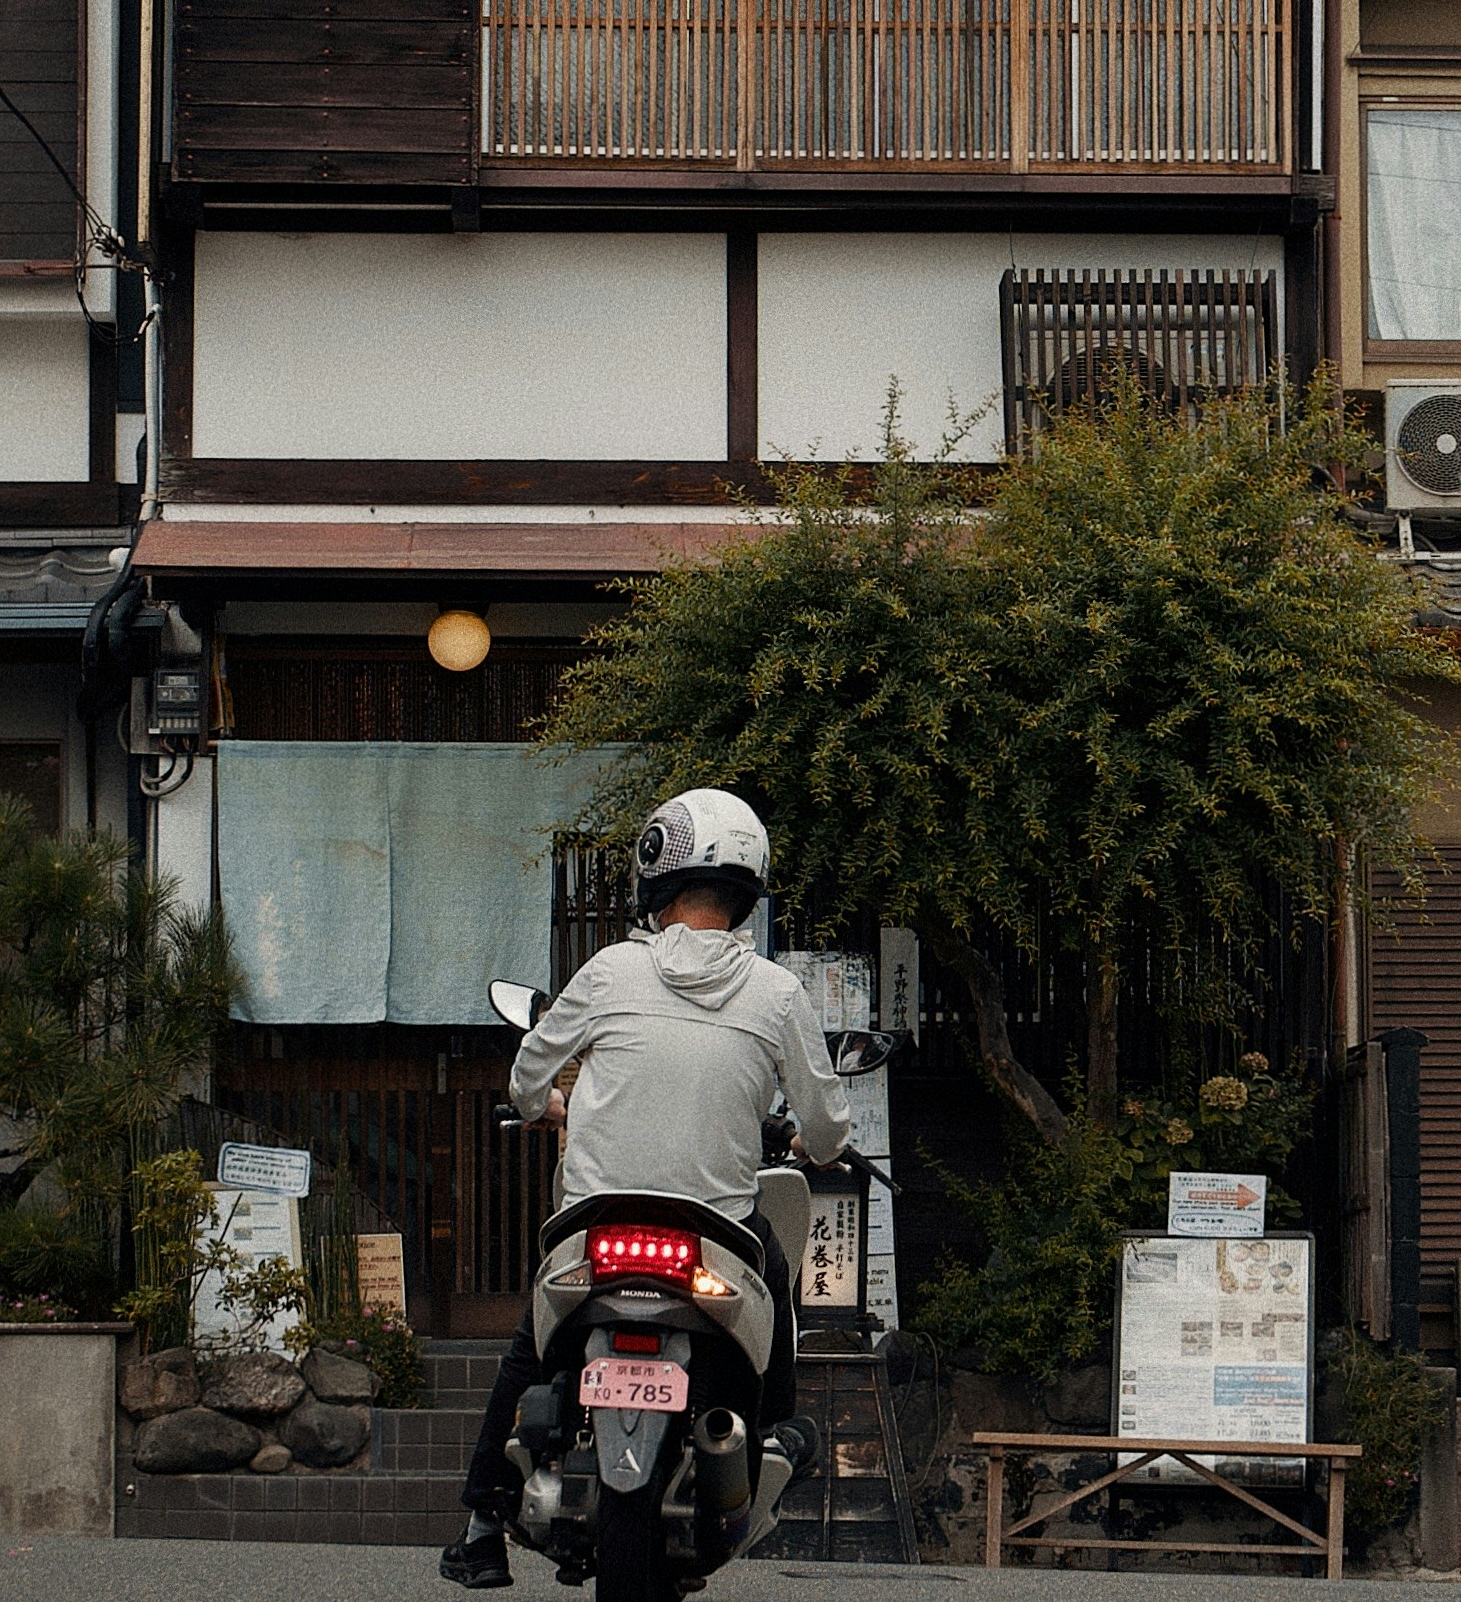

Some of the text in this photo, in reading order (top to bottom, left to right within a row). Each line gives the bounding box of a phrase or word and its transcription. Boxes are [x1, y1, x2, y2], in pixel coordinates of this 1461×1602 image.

[805, 1215, 834, 1298] 花巻屋
[620, 1289, 661, 1299] HONDA
[616, 1365, 655, 1377] 京都市
